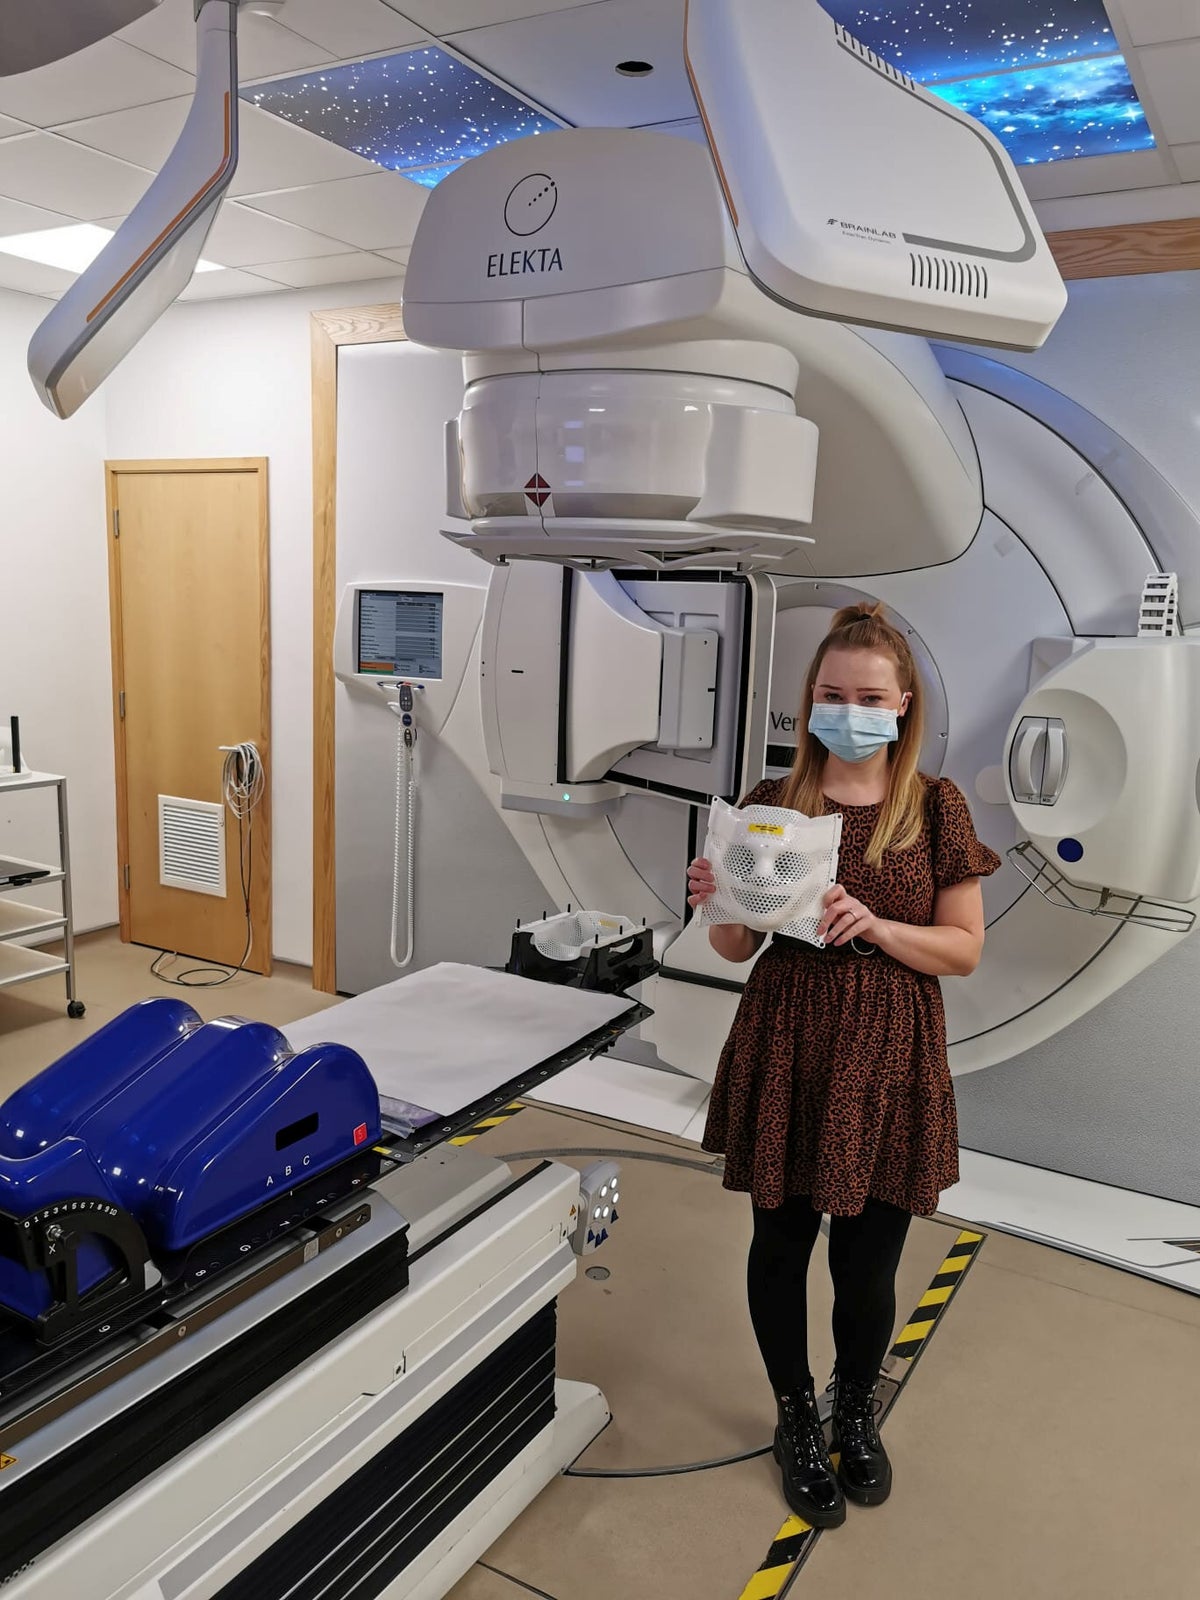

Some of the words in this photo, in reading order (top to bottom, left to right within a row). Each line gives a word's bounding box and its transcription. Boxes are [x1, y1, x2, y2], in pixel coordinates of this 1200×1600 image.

[840, 221, 897, 239] BRAINLAB
[487, 247, 563, 278] ELEKTA
[265, 1175, 274, 1187] A
[284, 1165, 292, 1177] B
[302, 1155, 311, 1166] C
[24, 1221, 31, 1229] 0
[34, 1215, 40, 1223] 1
[43, 1210, 50, 1218] 2
[53, 1206, 59, 1215] 3
[71, 1202, 78, 1210] 5
[80, 1201, 87, 1209] 6
[96, 1203, 103, 1211] 8
[104, 1205, 110, 1213] 9
[48, 1243, 56, 1255] X
[239, 1244, 252, 1252] G
[195, 1269, 207, 1277] 8
